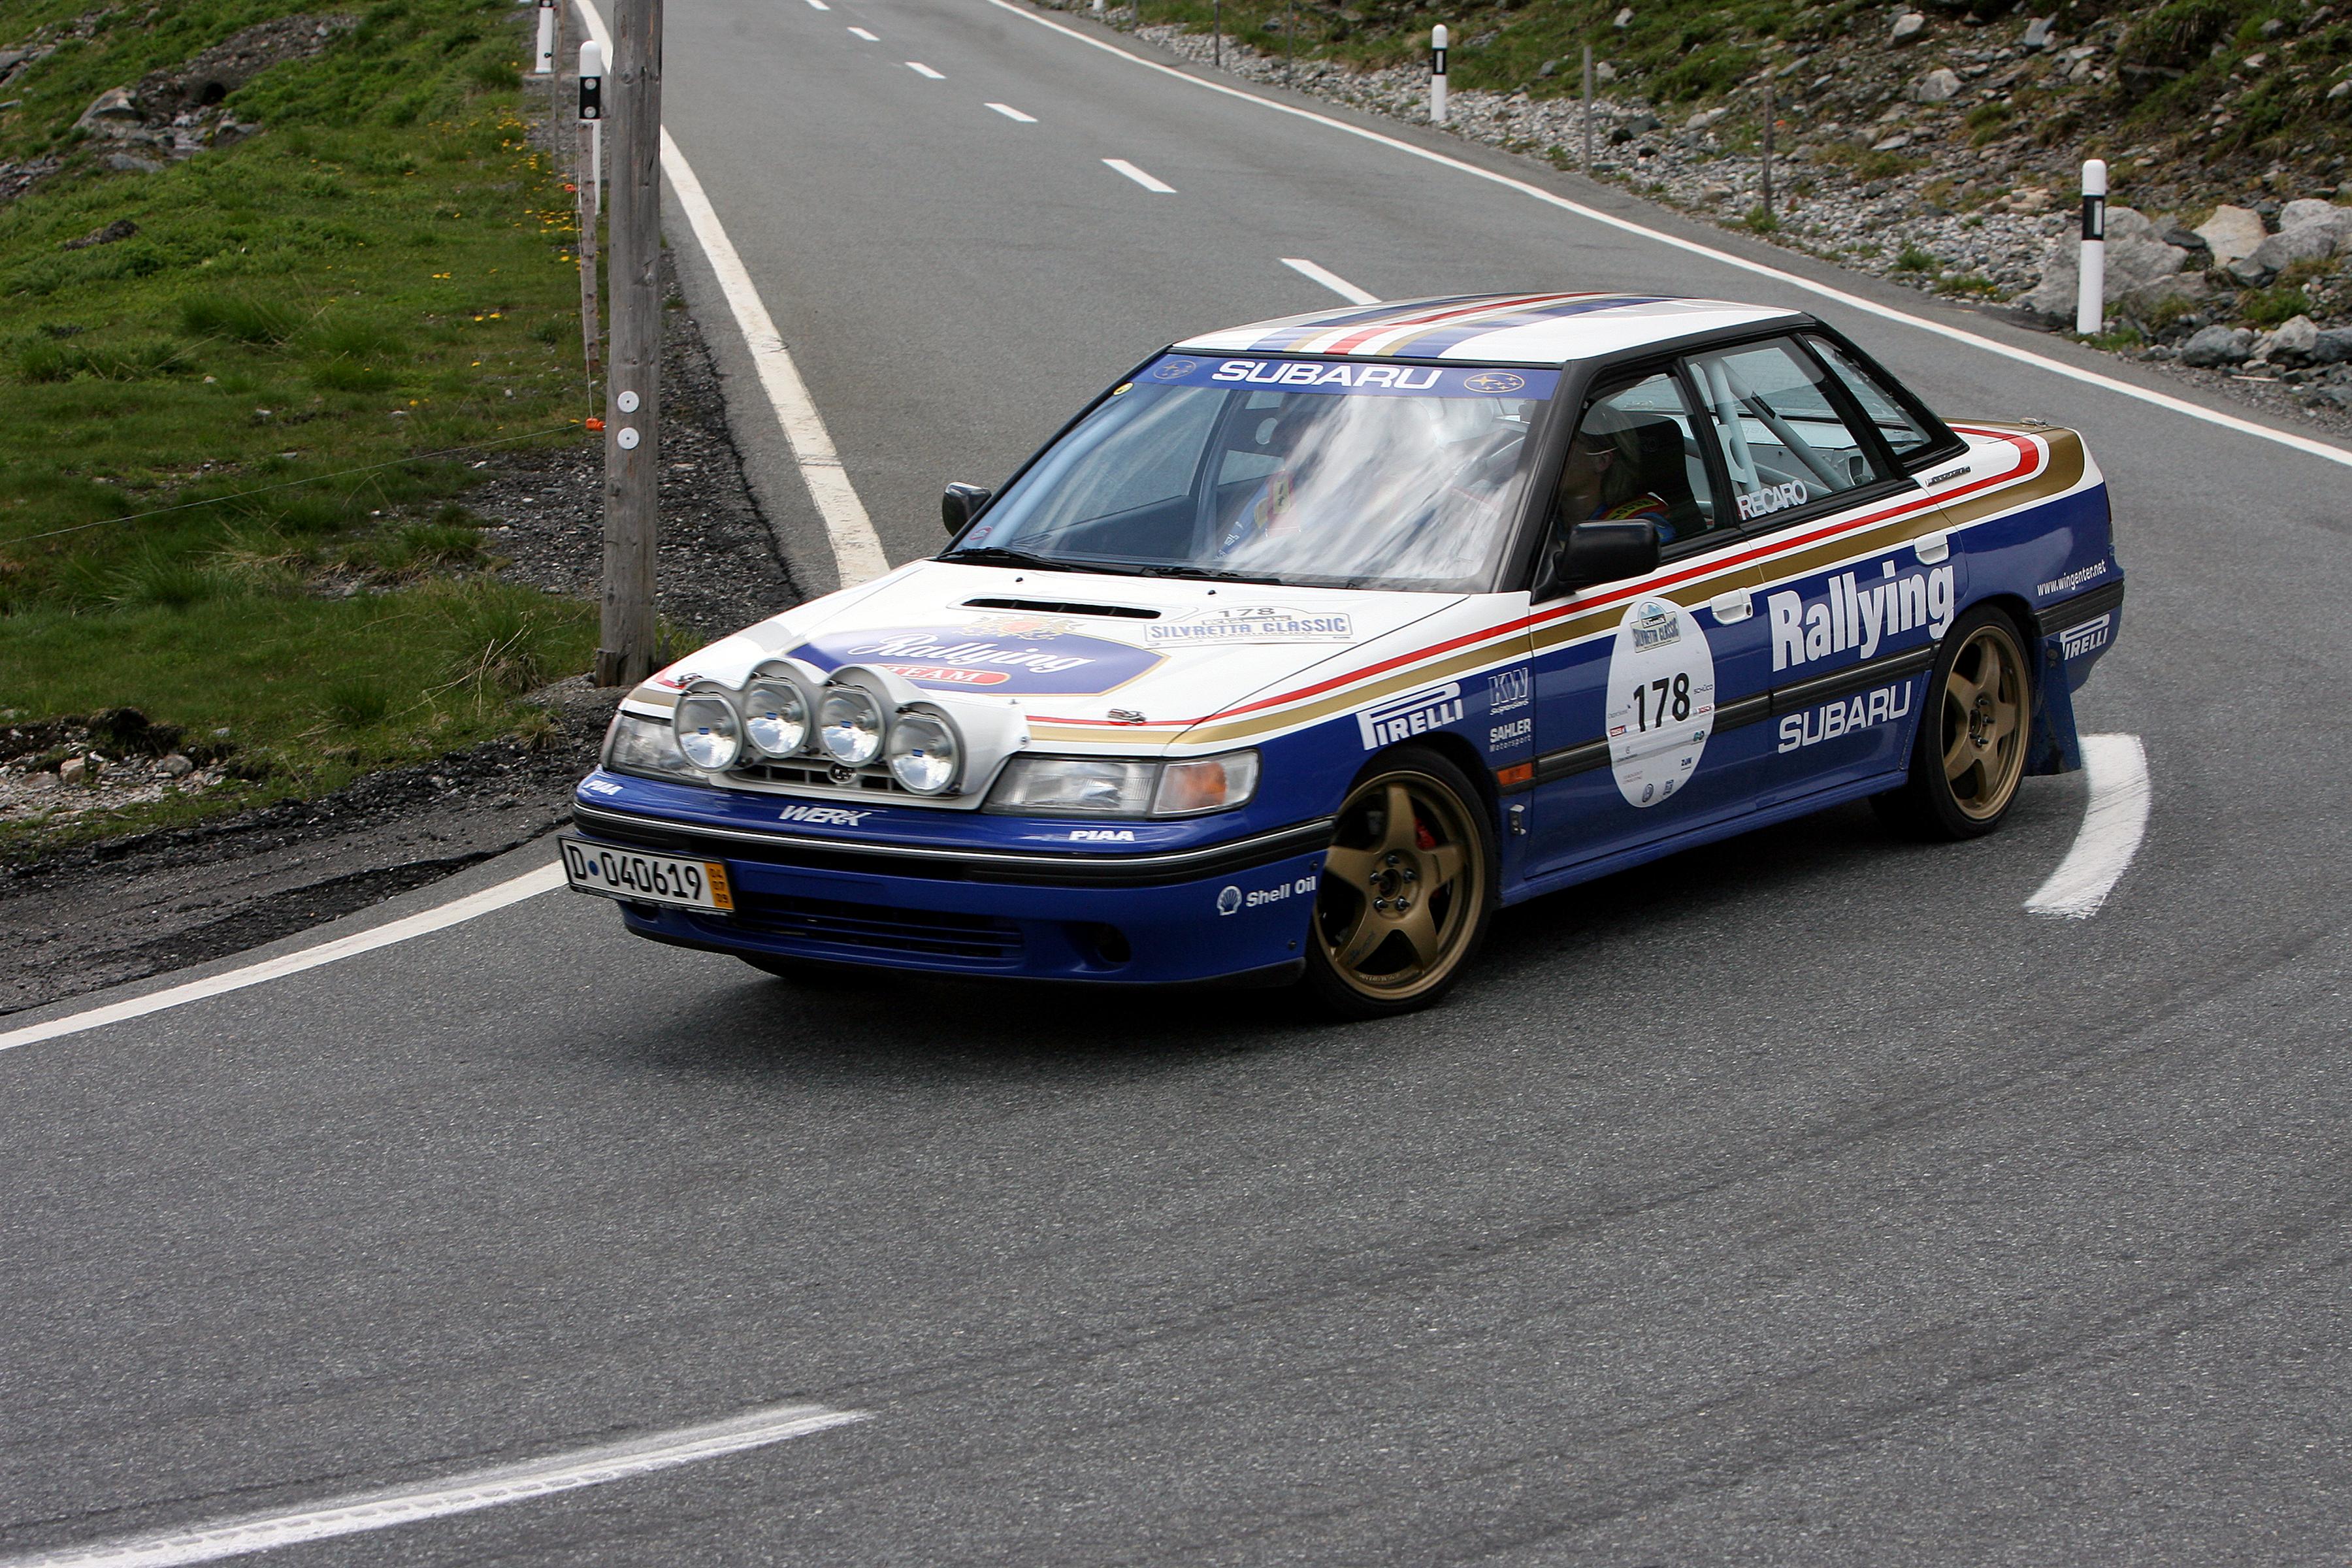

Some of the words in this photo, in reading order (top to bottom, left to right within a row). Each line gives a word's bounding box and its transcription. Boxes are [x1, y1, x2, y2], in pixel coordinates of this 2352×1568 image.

[1211, 359, 1443, 390] SUBARU
[1736, 480, 1808, 520] RECARO
[2036, 559, 2106, 596] www.wingenter.net
[1151, 624, 1251, 638] SILVRETTA
[1263, 617, 1347, 632] CLASSIC
[1218, 608, 1275, 617] 178
[1767, 559, 1954, 672] Rallying
[847, 632, 1096, 673] Rallying
[2059, 613, 2110, 661] PIRELLI
[887, 666, 985, 681] TEAM
[1488, 667, 1528, 706] KW
[1355, 681, 1464, 751] PIRELLI
[1633, 672, 1691, 732] 178
[1778, 680, 1912, 754] SUBARU
[1490, 718, 1531, 743] SAHLER
[1068, 830, 1135, 842] PIAA
[566, 844, 587, 881] D
[600, 851, 702, 900] 040619
[1245, 883, 1291, 907] Shell
[1294, 875, 1316, 894] Oil
